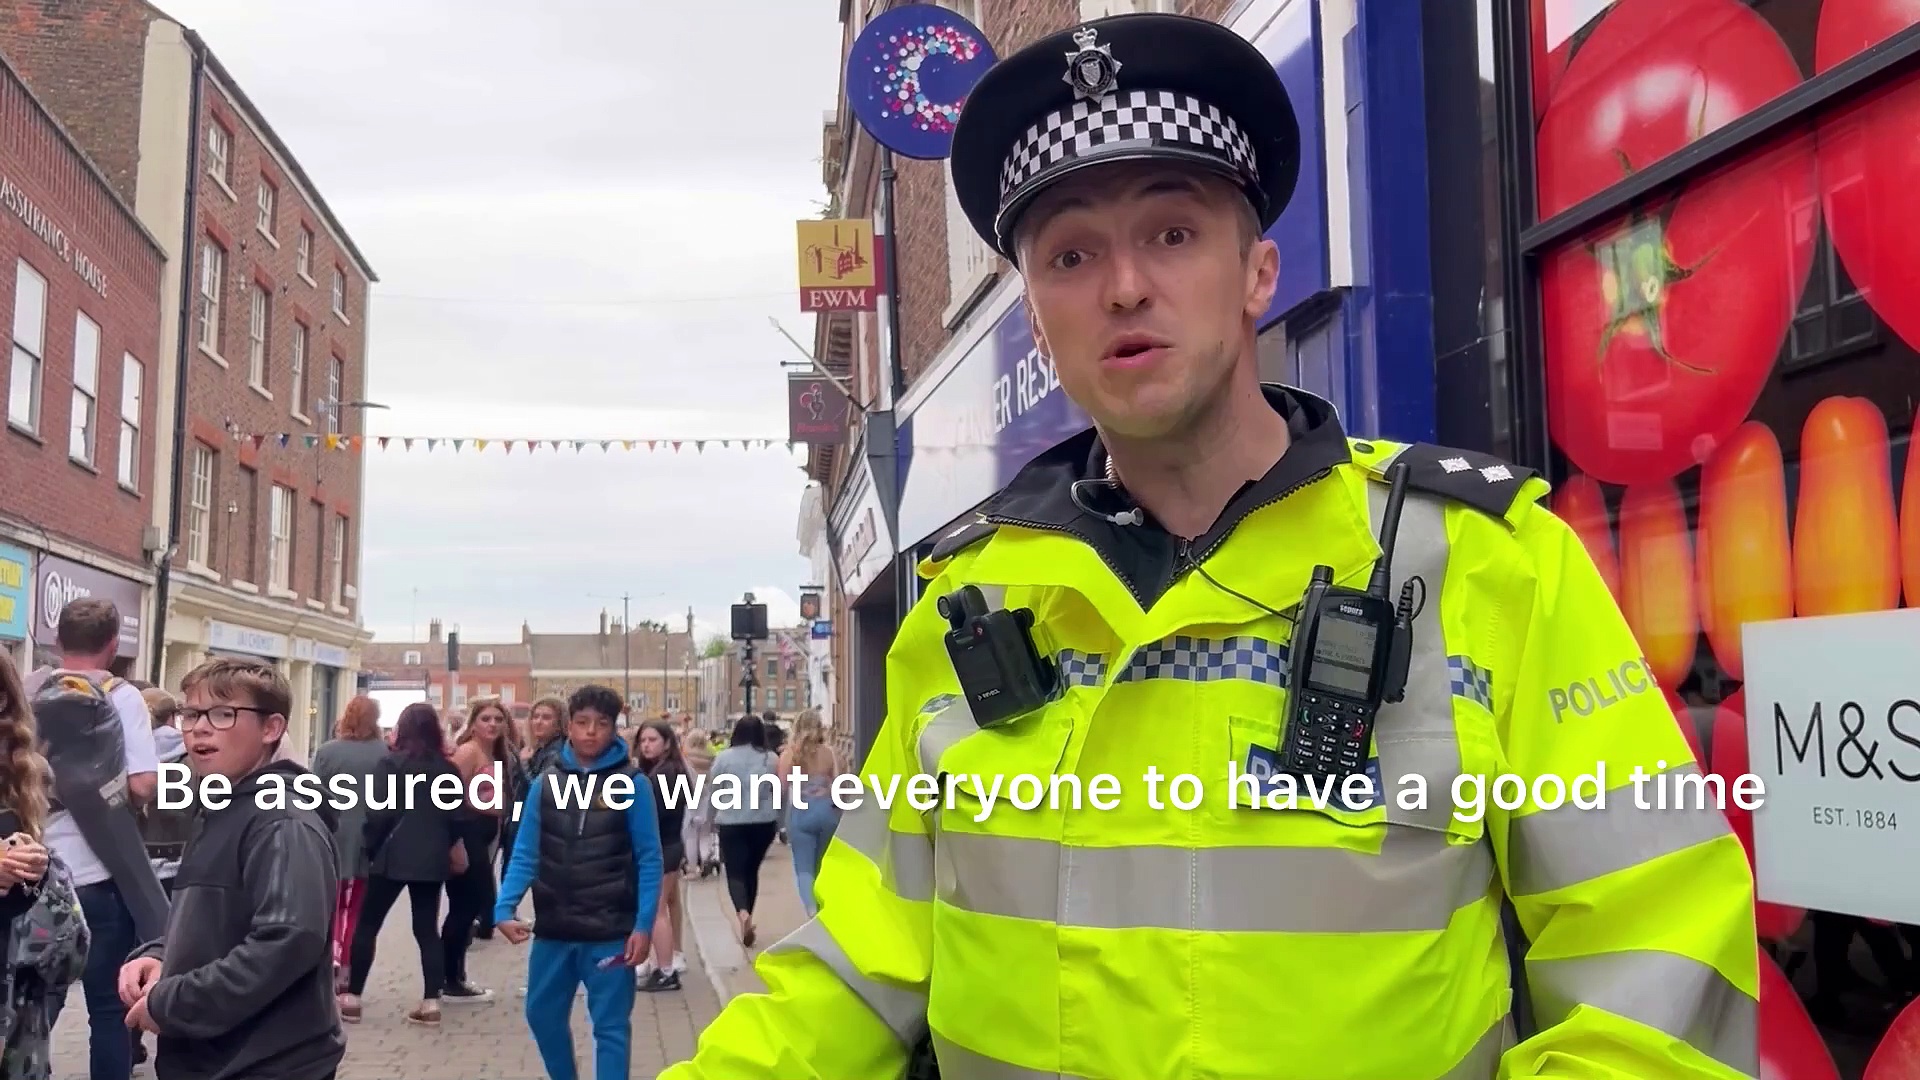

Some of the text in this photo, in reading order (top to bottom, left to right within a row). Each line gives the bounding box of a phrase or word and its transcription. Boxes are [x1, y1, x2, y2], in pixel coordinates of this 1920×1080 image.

[0, 175, 108, 299] ASSURANCE HOUSE
[809, 289, 867, 308] EWM
[1773, 699, 1920, 783] M&S
[1813, 806, 1897, 831] EST. 1884
